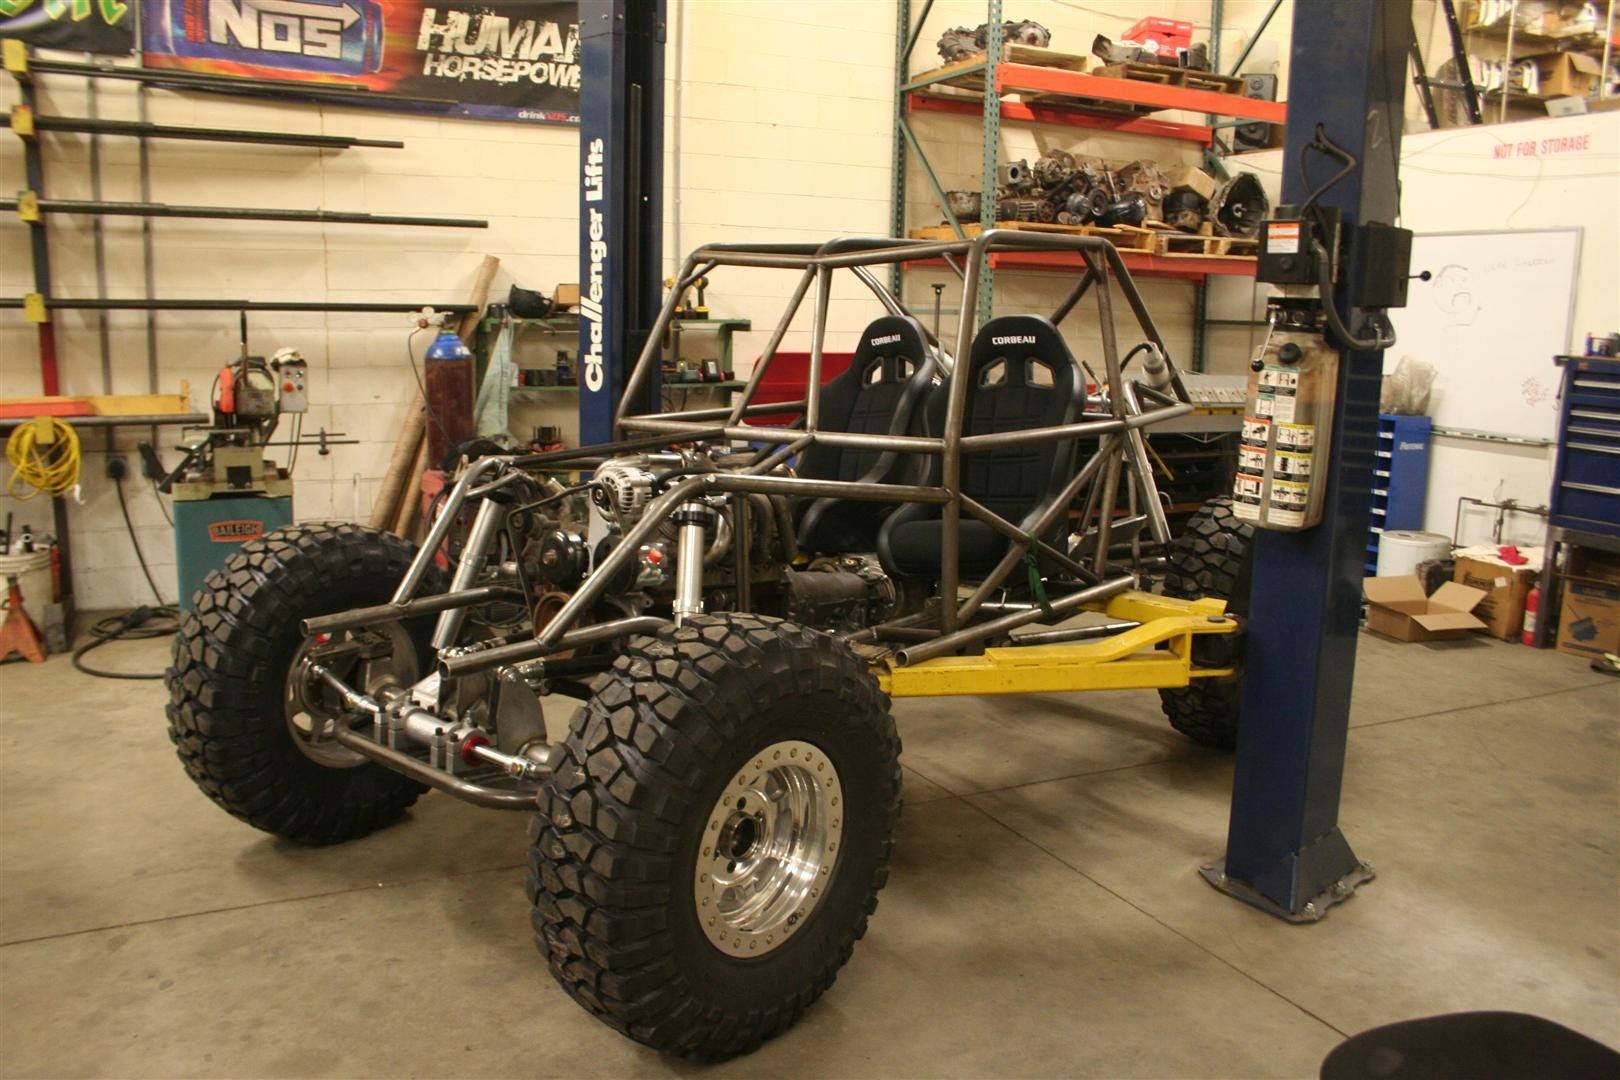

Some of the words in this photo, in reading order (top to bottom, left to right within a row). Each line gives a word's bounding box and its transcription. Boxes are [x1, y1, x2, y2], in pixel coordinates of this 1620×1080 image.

[208, 0, 350, 60] NOS
[1493, 143, 1513, 159] NOT
[1516, 141, 1537, 157] FOR
[1541, 135, 1590, 154] STORAGE
[584, 138, 603, 201] Lifts
[580, 208, 607, 393] Challenger
[870, 333, 901, 346] CORBEAU
[991, 335, 1036, 345] CORBEAU
